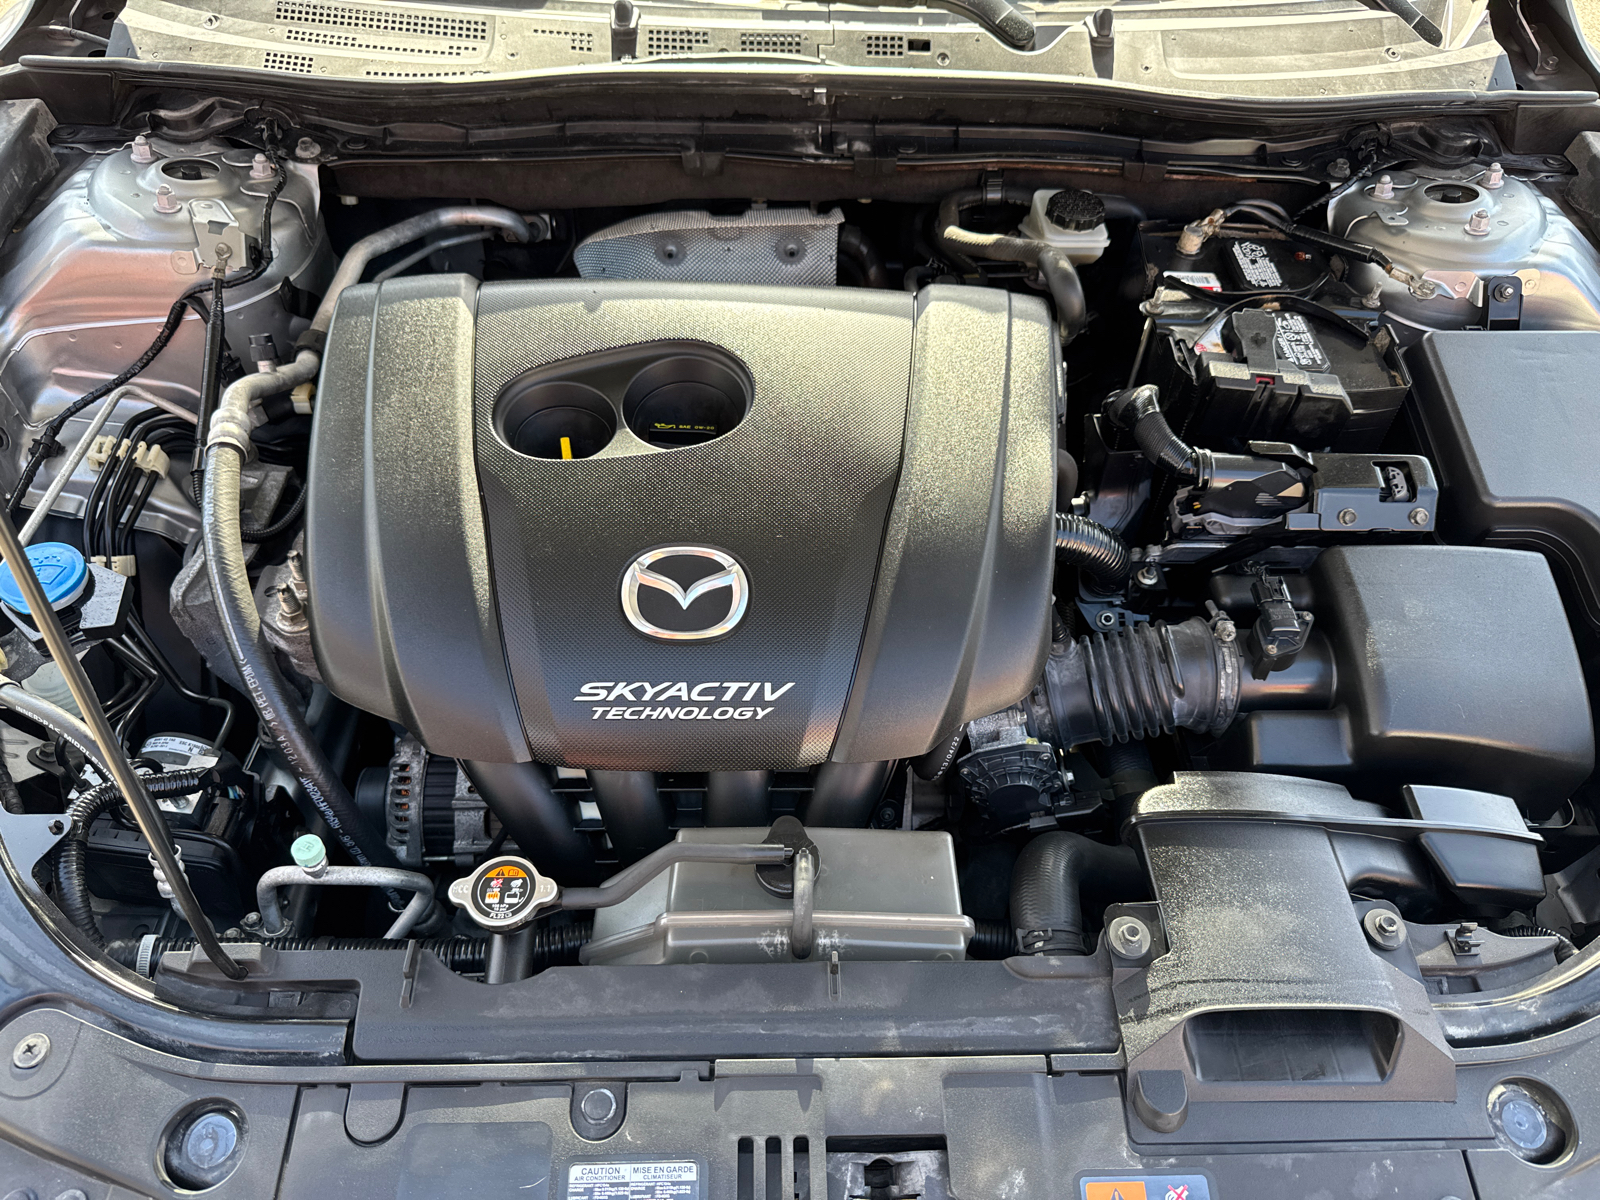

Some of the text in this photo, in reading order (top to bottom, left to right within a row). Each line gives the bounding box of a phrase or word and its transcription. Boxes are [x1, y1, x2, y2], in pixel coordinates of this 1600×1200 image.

[573, 682, 796, 702] SKYACTIV
[592, 706, 774, 720] TECHNOLOGY
[582, 1167, 620, 1176] CAUTION
[667, 1166, 694, 1174] GARDE
